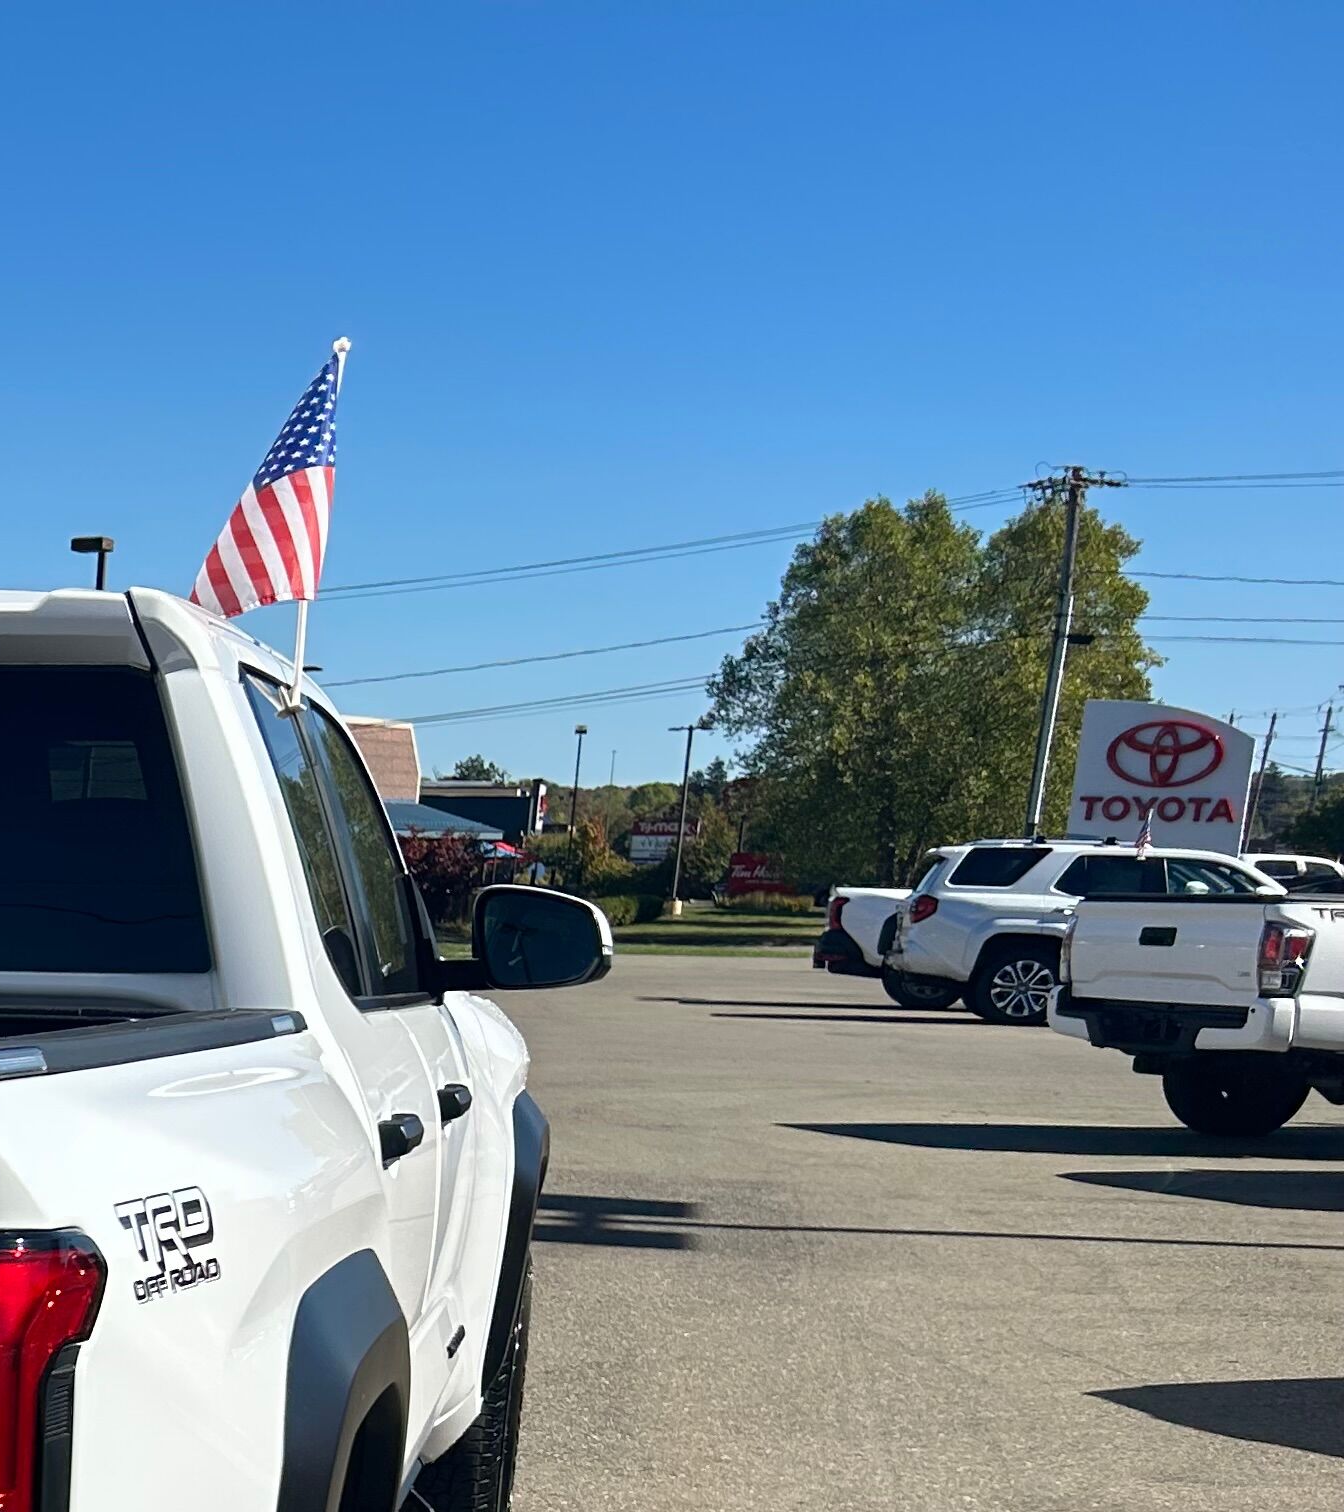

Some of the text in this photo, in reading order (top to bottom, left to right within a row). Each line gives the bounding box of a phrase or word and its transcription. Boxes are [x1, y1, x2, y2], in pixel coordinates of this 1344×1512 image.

[1080, 796, 1234, 823] TOYOTA
[1311, 907, 1344, 922] TR
[113, 1186, 214, 1273] TRD
[133, 1258, 221, 1304] OFF ROAD
